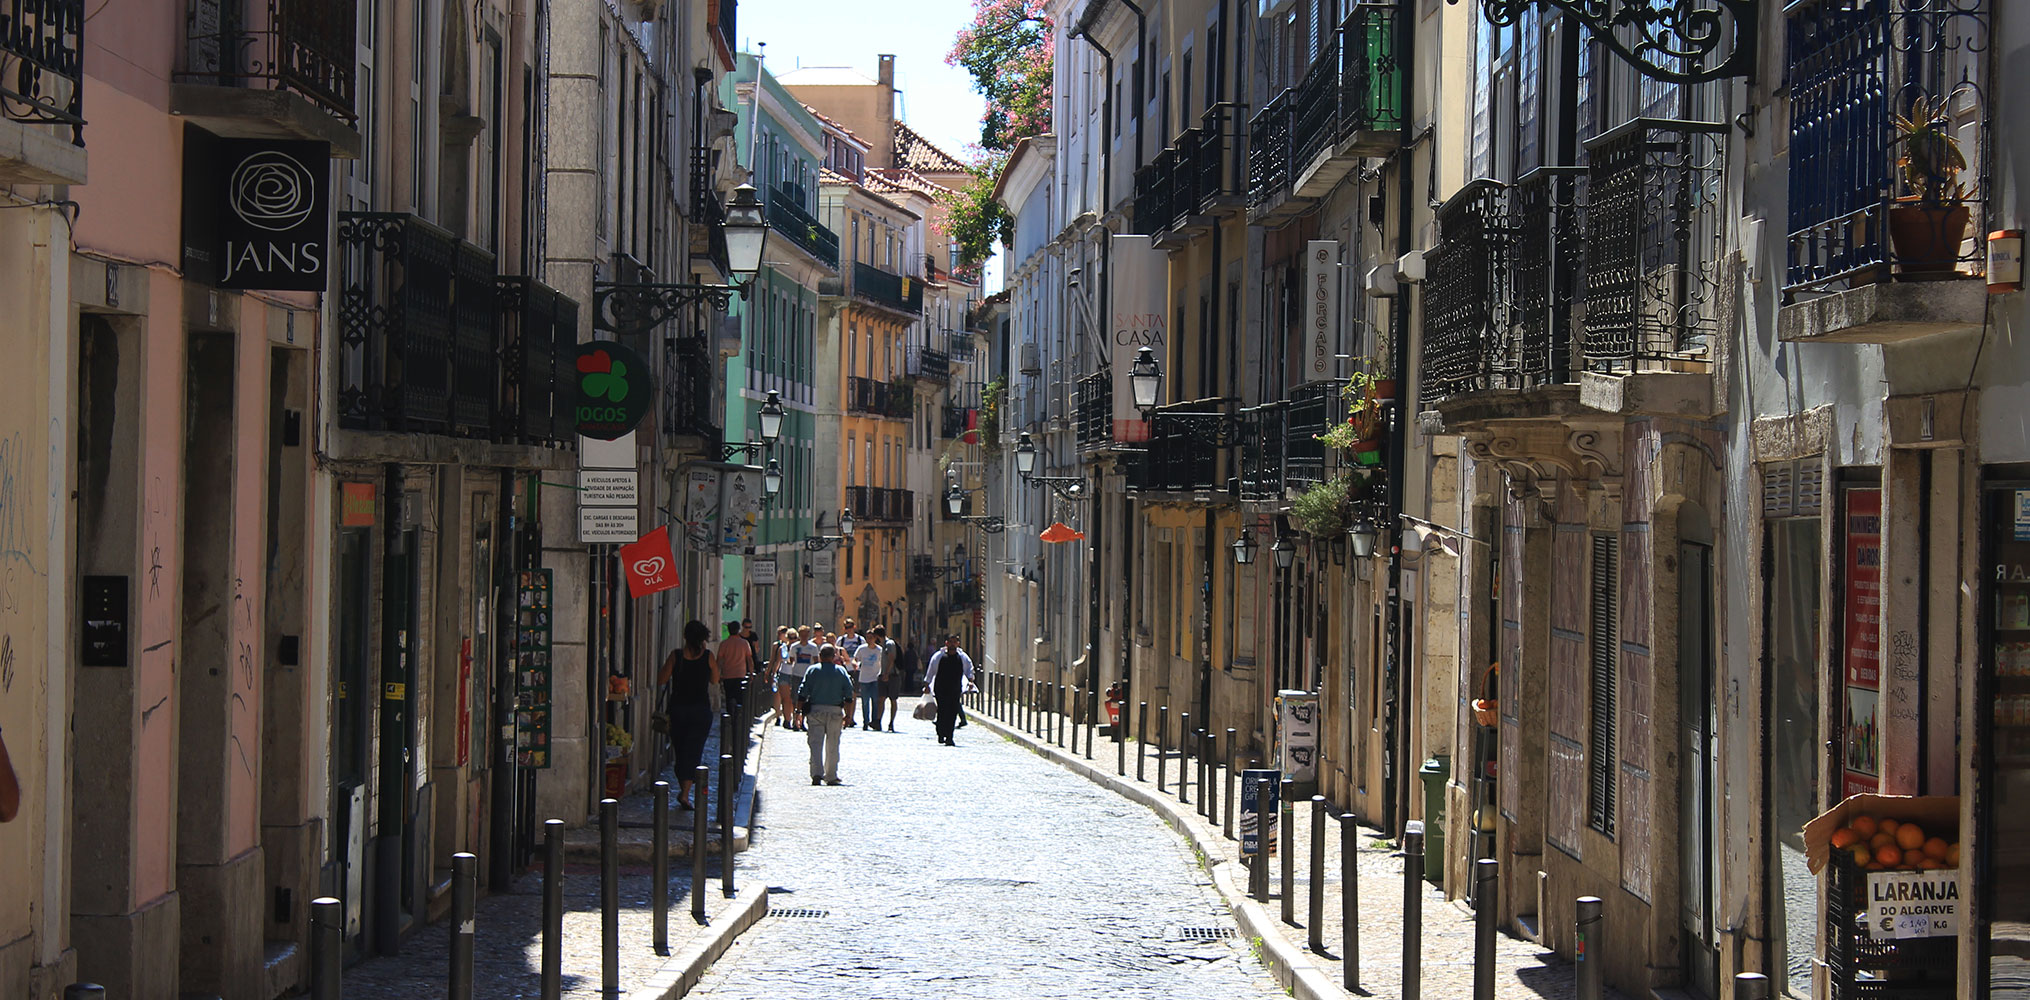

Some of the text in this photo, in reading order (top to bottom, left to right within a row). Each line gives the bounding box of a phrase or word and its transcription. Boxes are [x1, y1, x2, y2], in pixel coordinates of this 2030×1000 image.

[221, 240, 320, 283] JANS
[1115, 313, 1164, 328] SANTA
[1314, 273, 1329, 372] FORCADO
[1115, 330, 1164, 346] CASA
[576, 406, 627, 425] JOGOS
[1874, 881, 1959, 902] LARANJA
[1880, 905, 1954, 915] DO ALGARVE
[1879, 917, 1893, 932] €
